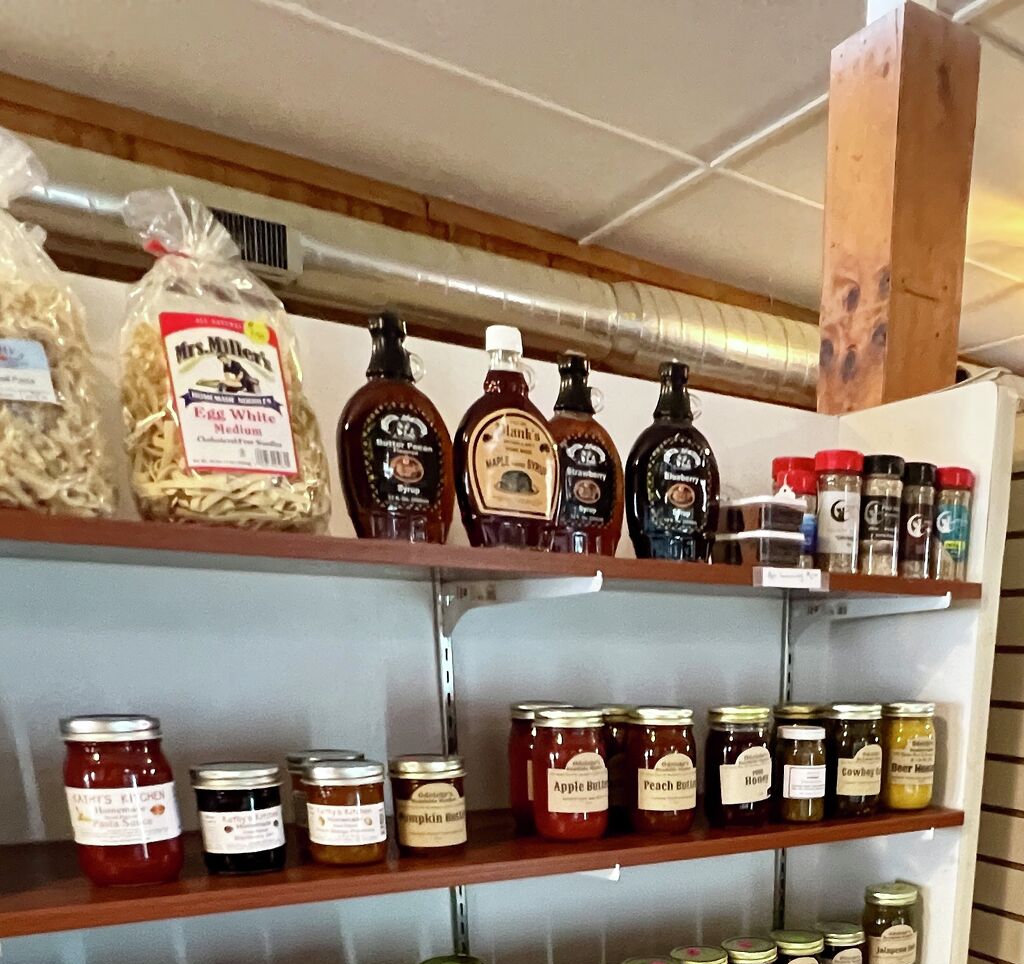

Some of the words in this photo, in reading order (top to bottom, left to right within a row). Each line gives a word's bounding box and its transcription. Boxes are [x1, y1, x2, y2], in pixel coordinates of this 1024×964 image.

[175, 341, 208, 365] Mrs.
[207, 335, 273, 373] Miller's
[193, 407, 226, 421] Egg
[229, 408, 276, 424] White
[213, 423, 263, 437] Medium
[503, 424, 541, 441] lank's
[397, 483, 421, 496] Syrup
[841, 767, 875, 778] Cowboy
[890, 762, 912, 774] Beer
[553, 780, 585, 794] Apple
[586, 779, 608, 792] Butte
[643, 780, 674, 791] Peach
[94, 806, 146, 815] Homemae
